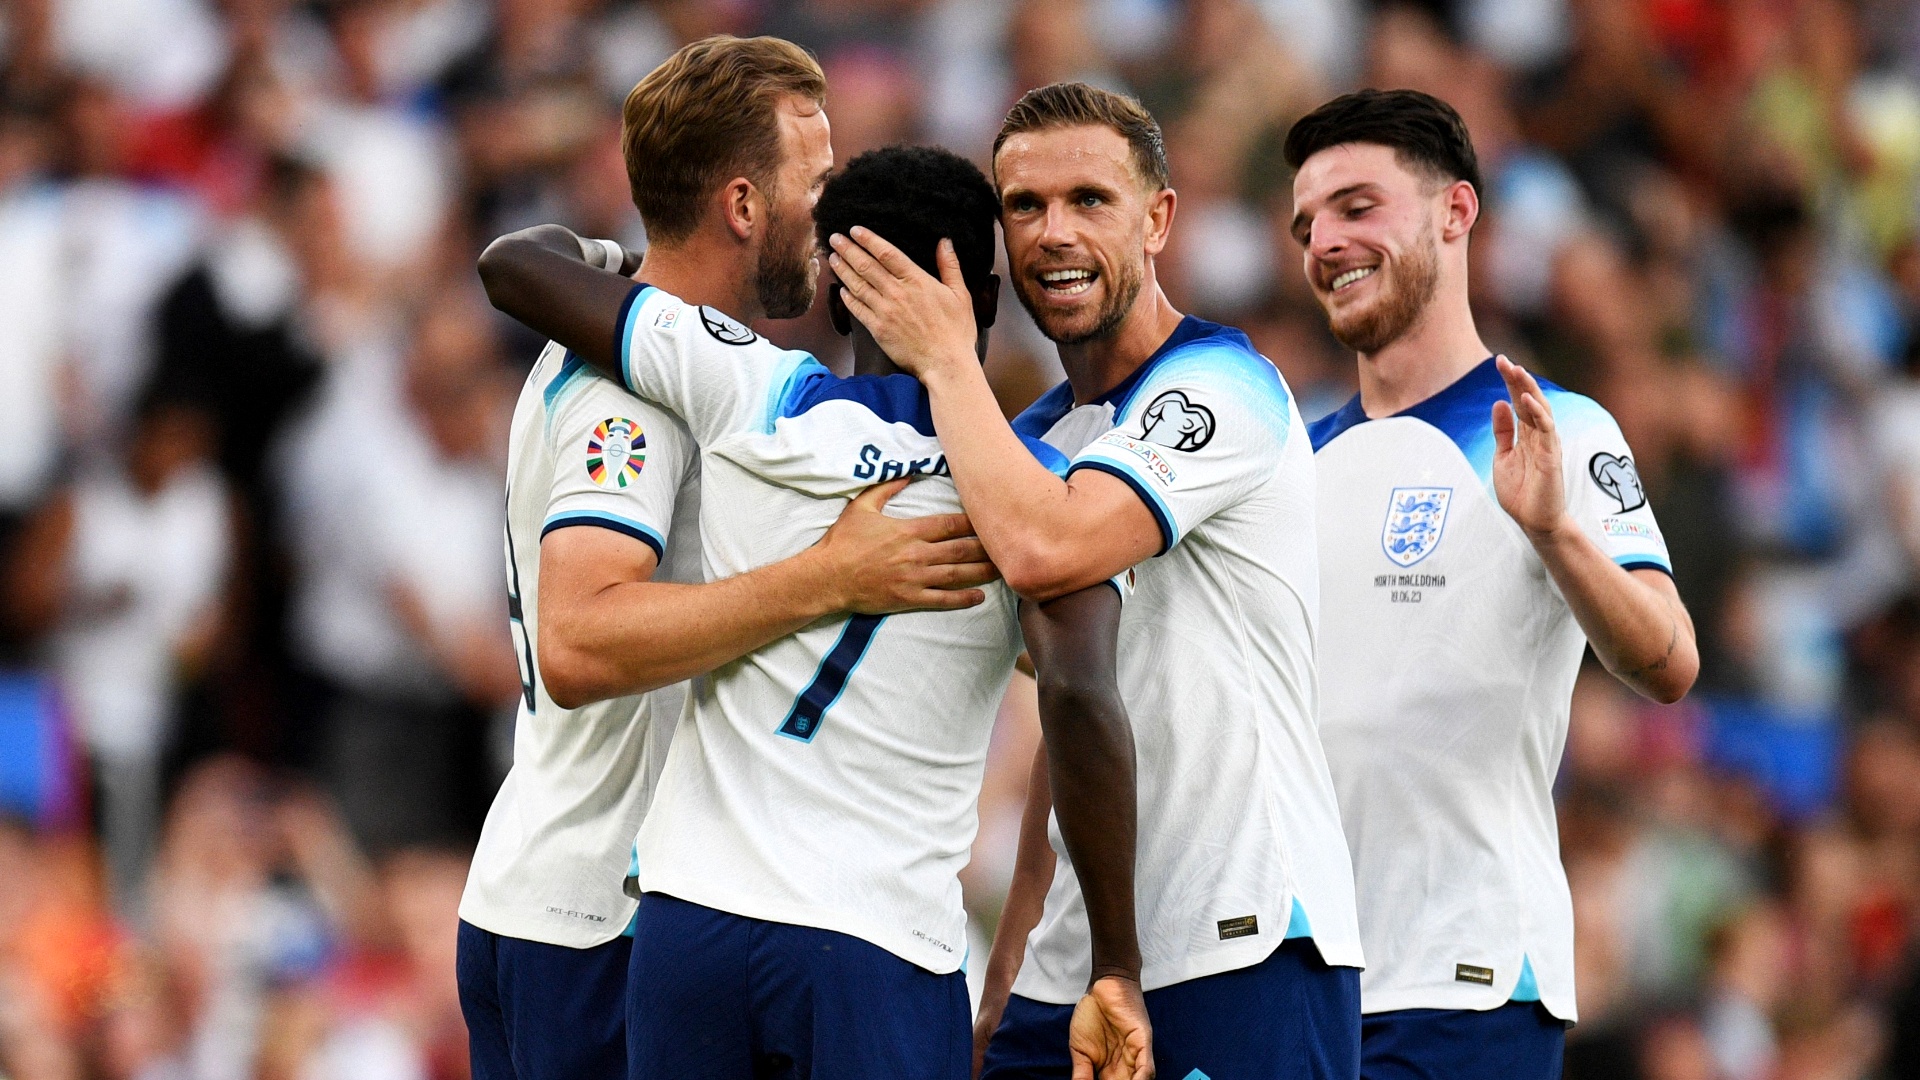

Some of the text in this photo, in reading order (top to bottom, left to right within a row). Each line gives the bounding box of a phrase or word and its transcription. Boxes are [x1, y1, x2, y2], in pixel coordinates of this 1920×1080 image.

[1102, 435, 1176, 483] FOUNDATION
[1374, 574, 1446, 588] NORTH MACEDONIA
